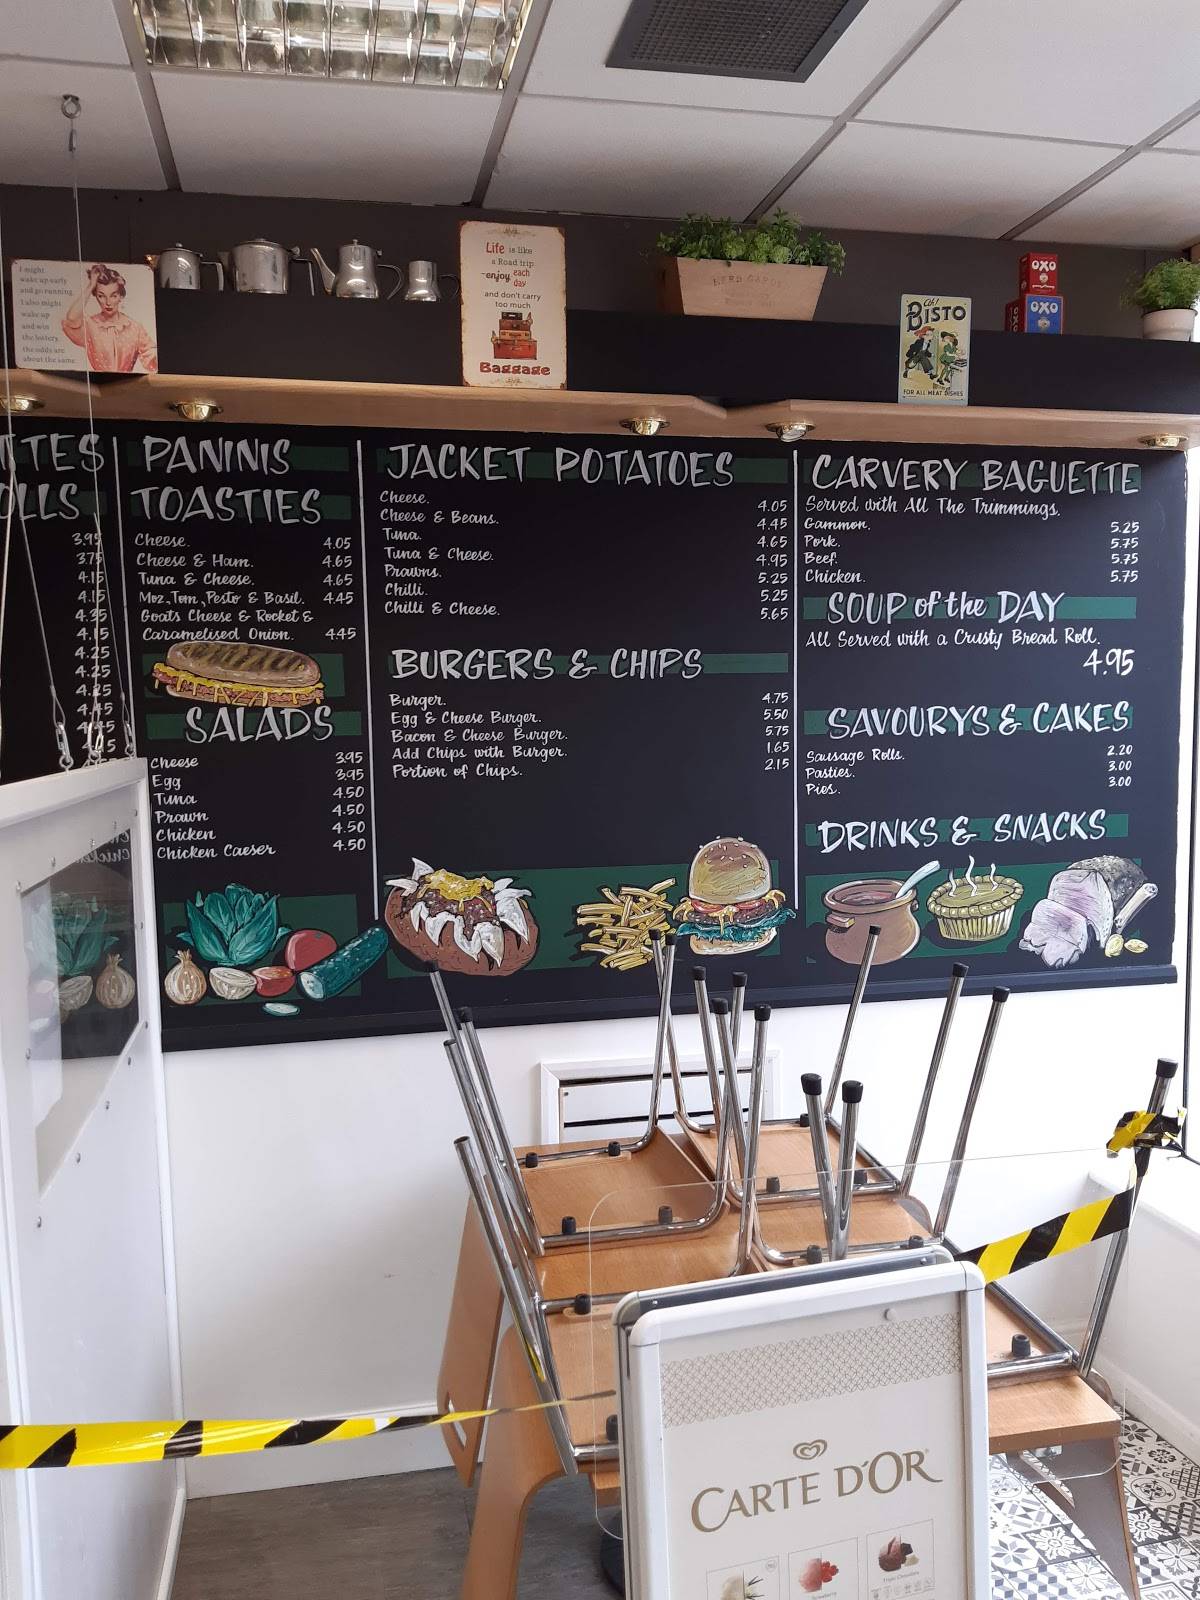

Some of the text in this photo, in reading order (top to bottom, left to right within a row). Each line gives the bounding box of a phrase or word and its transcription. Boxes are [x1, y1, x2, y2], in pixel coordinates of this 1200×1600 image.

[486, 242, 505, 254] Life
[498, 257, 518, 266] Road
[1031, 260, 1057, 272] OXO
[485, 269, 530, 283] enjoy each
[513, 279, 527, 288] day
[522, 293, 541, 302] carry
[906, 301, 966, 332] BISTO
[1030, 301, 1059, 315] OXO
[479, 361, 551, 376] Baggage
[143, 436, 290, 475] PANINIS
[387, 444, 733, 487] JACKET POTATOES
[812, 454, 1139, 494] CARVERY BAGUETTE
[131, 486, 321, 524] TOASTIES
[379, 490, 787, 512] Cheese. 4.05
[805, 495, 1061, 521] Served with All The Trimmings.
[380, 509, 788, 531] Cheese & Beans. 4.45
[804, 518, 1140, 534] Gammon. 5.25
[72, 532, 102, 546] 3.95
[135, 533, 352, 550] Cheese. 4.05
[382, 528, 788, 548] Tuna. 4.65
[804, 535, 1139, 549] Pork. 5.75
[137, 553, 352, 568] Cheese & Ham. 4.65
[384, 547, 788, 567] Tuna & Cheese. 4.95
[803, 552, 1139, 566] Beef. 5.75
[78, 571, 104, 584] 4.15
[138, 572, 353, 586] Tuna & Cheese. 4.65
[384, 564, 788, 584] Prawns. 5.25
[805, 569, 1139, 584] Chicken. 5.75
[264, 591, 305, 605] Basil.
[323, 592, 354, 605] 4.45
[385, 583, 789, 602] Chilli. 5.25
[141, 609, 300, 623] Goats Cheese & Rocket
[384, 601, 789, 621] Chilli & Cheese. 5.65
[827, 591, 1065, 625] SOUP of the DAY
[142, 627, 357, 641] Caramelised Onion. 4.45
[805, 627, 1101, 650] All Served with a Crusty Bread Roll.
[392, 648, 702, 680] BURGERS & CHIPS
[1083, 648, 1135, 676] 4.95
[389, 692, 789, 711] Burger. 4.75
[186, 705, 334, 744] SALADS
[391, 709, 789, 728] Egg & Cheese Burger. 5.50
[828, 701, 1130, 739] SAVOURYS & CAKES
[391, 725, 790, 745] Bacon & Cheese Burger. 5.75
[151, 751, 363, 769] Cheese 3.95
[392, 741, 790, 762] Add Chips with Burger. 1.65
[806, 744, 1133, 766] Sausage Rolls. 2.20
[152, 768, 364, 790] Egg 3.95
[392, 758, 790, 781] Portion of Chips. 2.15
[805, 760, 1132, 779] Pasties. 3.00
[154, 785, 365, 805] Tuna 4.50
[805, 776, 1132, 795] Pies. 3.00
[155, 803, 365, 824] Prawn 4.50
[156, 820, 366, 842] Chicken 4.50
[818, 809, 1106, 853] DRINKS & SNACKS
[157, 838, 366, 860] Chicken Caeser 4.50
[690, 1472, 821, 1533] CARTE
